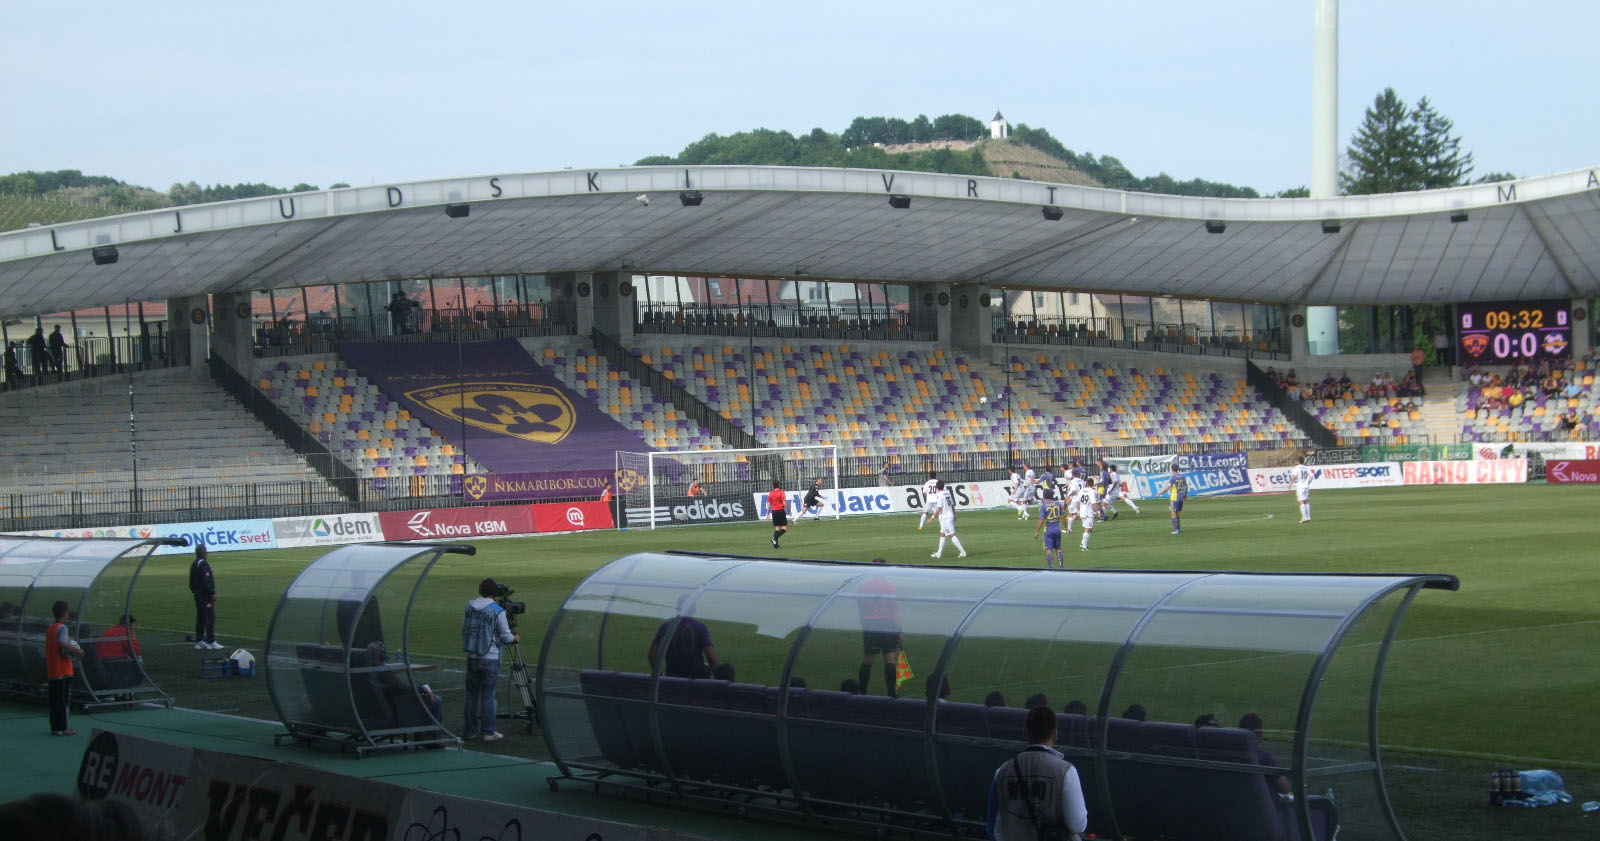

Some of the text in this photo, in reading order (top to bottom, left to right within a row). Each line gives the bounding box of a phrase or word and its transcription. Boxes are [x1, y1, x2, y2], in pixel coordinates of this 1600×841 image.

[882, 173, 1057, 205] VRT
[1486, 310, 1544, 329] 09:32
[1494, 332, 1537, 358] 0:0
[1145, 459, 1171, 474] dem
[1323, 466, 1391, 480] INTERSPORT
[1404, 459, 1526, 484] RADIO CITY
[1270, 470, 1297, 484] ceti
[1571, 471, 1598, 482] Nova
[494, 477, 608, 493] NKMARIBOR.COM
[928, 485, 937, 495] 20
[673, 499, 745, 520] adidas
[832, 490, 891, 513] Jarc
[1046, 505, 1060, 520] 20
[333, 516, 372, 536] dem
[434, 520, 507, 536] Nova KBM
[240, 530, 271, 544] svet!
[83, 751, 114, 789] RE
